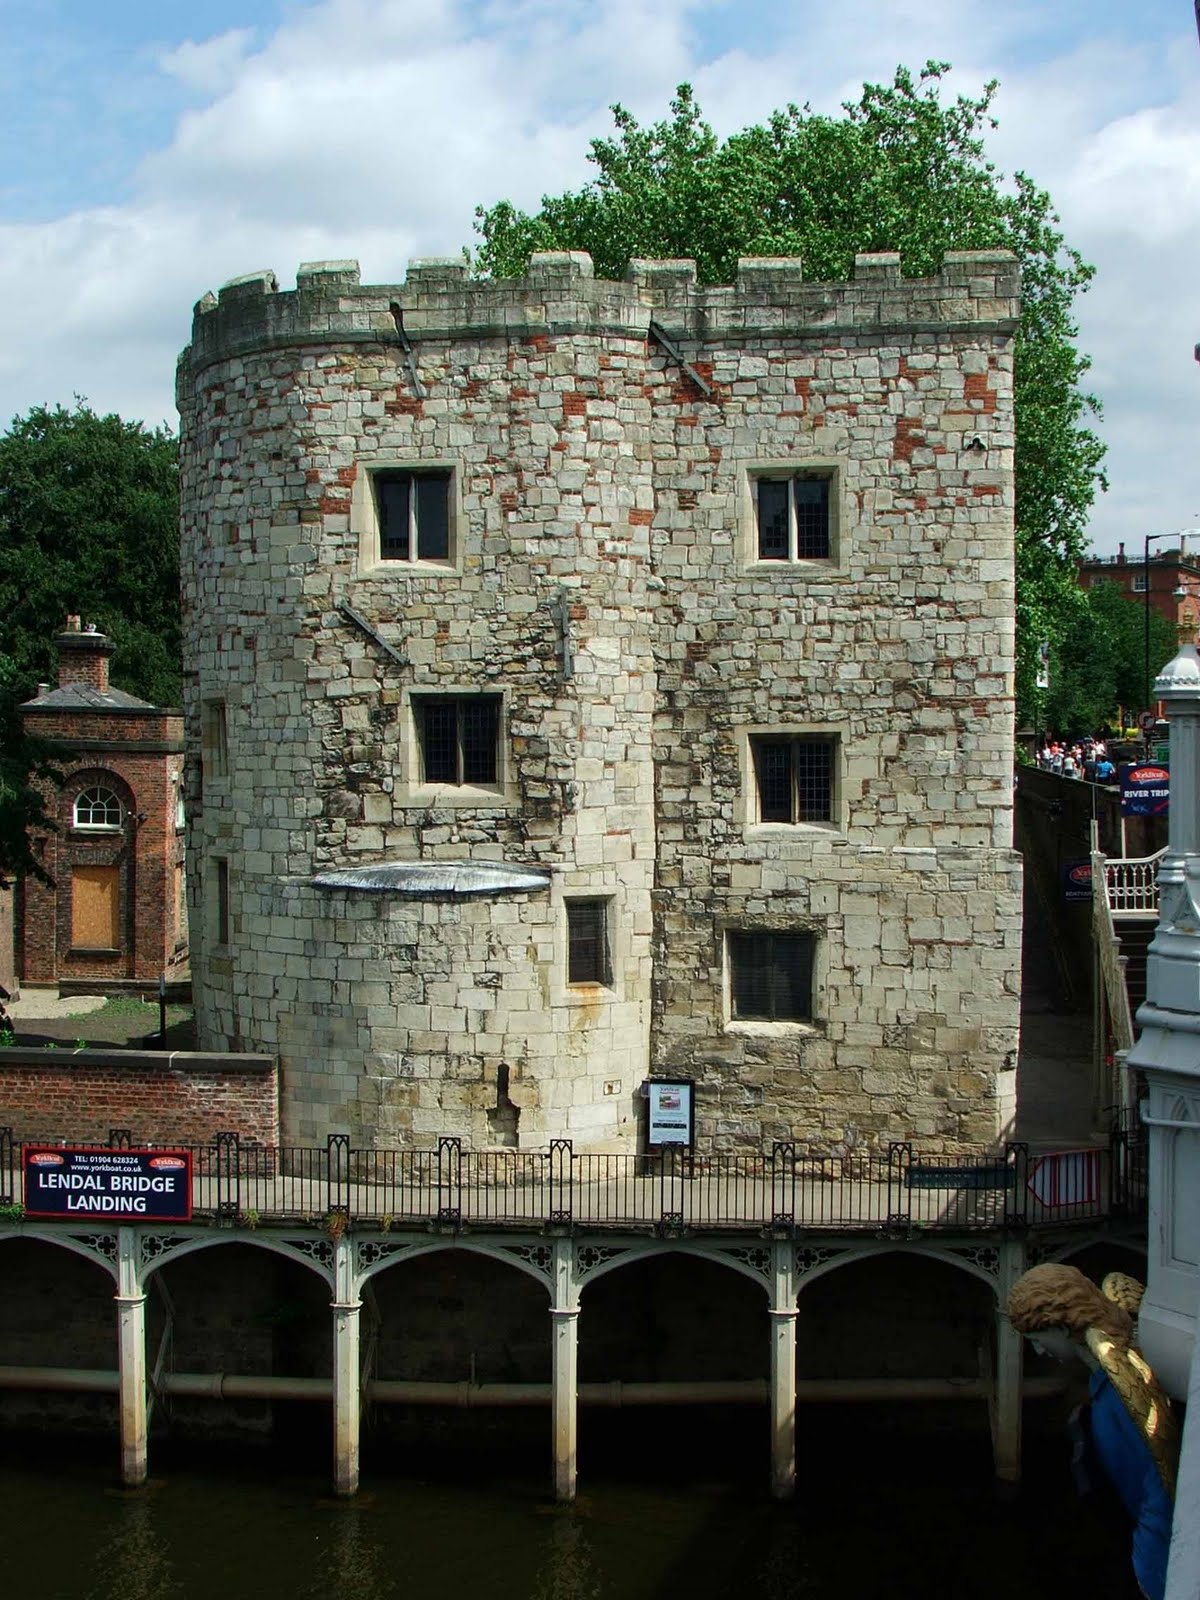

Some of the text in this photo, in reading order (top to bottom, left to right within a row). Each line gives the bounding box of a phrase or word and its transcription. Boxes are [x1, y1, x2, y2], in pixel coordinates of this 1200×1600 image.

[1124, 790, 1149, 798] RIVER
[74, 1155, 138, 1164] TEL: 01904 628324
[71, 1163, 142, 1172] www.yorkboat.co.uk
[39, 1173, 175, 1192] LENDAL BRIDGE
[67, 1195, 146, 1212] LANDING
